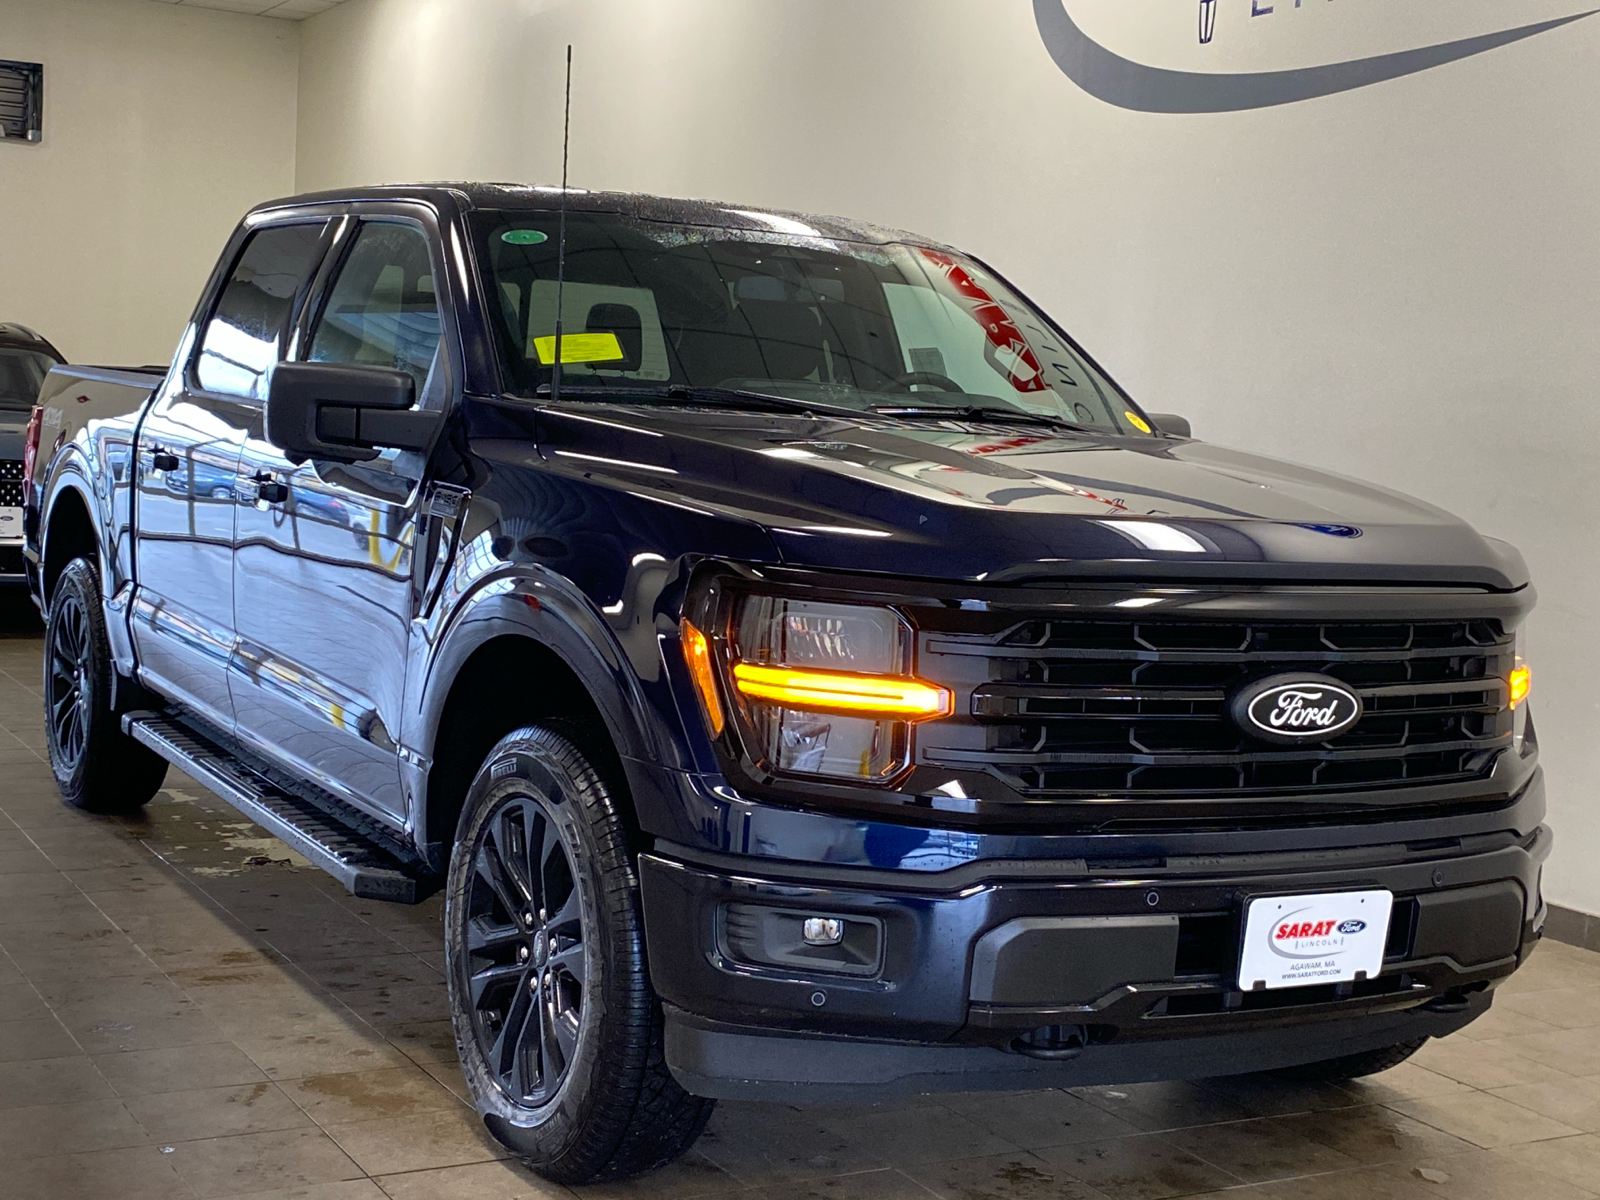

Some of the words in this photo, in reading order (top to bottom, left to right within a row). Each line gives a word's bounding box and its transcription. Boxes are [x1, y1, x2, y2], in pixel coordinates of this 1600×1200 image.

[1269, 690, 1339, 727] Ford
[491, 757, 517, 779] PIRELLI
[1276, 920, 1337, 939] SARAT
[1341, 921, 1362, 932] Ford
[1301, 939, 1338, 948] LINCOLN
[1290, 962, 1322, 971] AGAWAM,
[1324, 960, 1336, 968] MA
[1281, 969, 1341, 979] WWW.SARATFORD.COM
